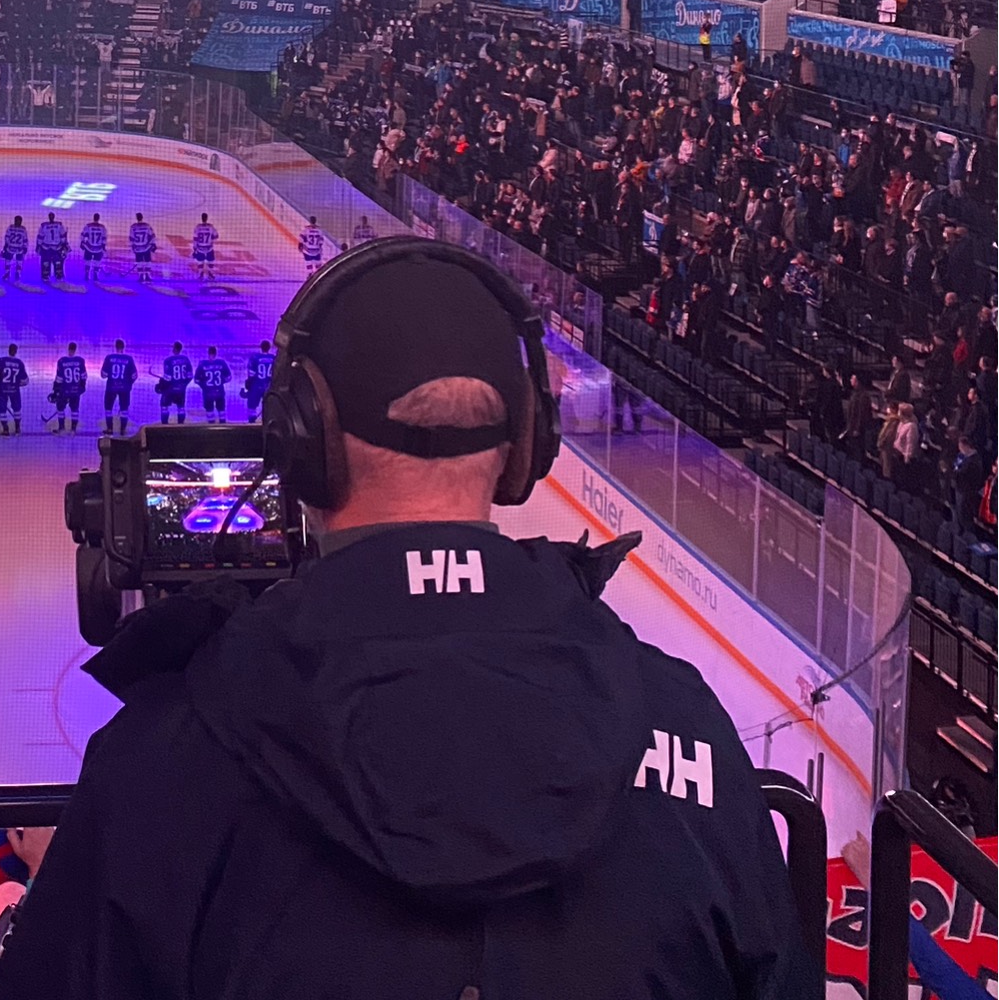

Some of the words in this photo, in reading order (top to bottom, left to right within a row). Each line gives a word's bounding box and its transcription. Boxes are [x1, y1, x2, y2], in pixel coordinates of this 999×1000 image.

[239, 1, 258, 10] ВТБ
[275, 2, 294, 12] ВТБ
[9, 233, 22, 244] 22
[3, 368, 20, 383] 27
[64, 368, 81, 383] 96
[205, 371, 222, 387] 23
[582, 469, 624, 534] Haier
[406, 549, 485, 595] HH
[657, 540, 718, 613] dynamo.ru
[634, 729, 714, 808] HH
